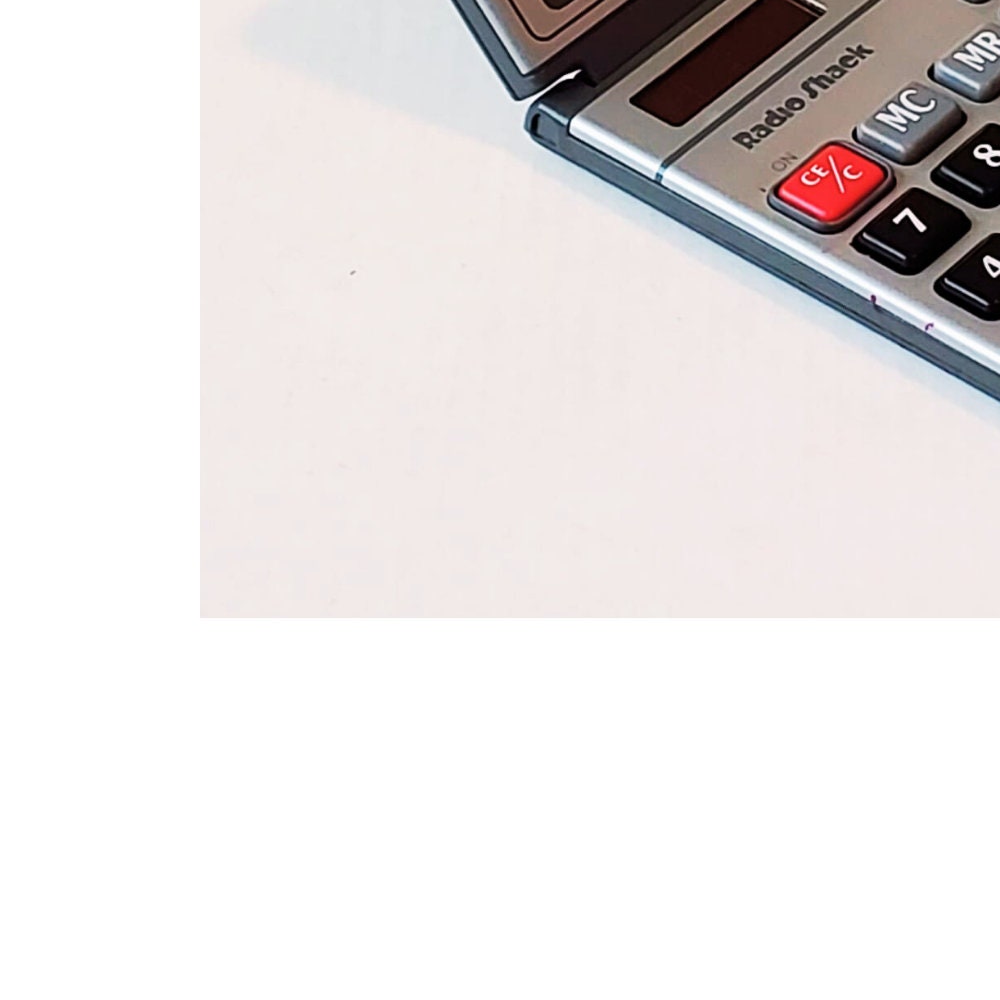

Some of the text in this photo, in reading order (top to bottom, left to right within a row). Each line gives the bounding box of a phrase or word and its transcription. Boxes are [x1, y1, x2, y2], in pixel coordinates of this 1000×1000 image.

[732, 43, 875, 150] Radio Shack
[876, 89, 935, 133] MC
[771, 152, 798, 172] ON
[800, 155, 864, 194] CE/C
[893, 208, 927, 233] 7
